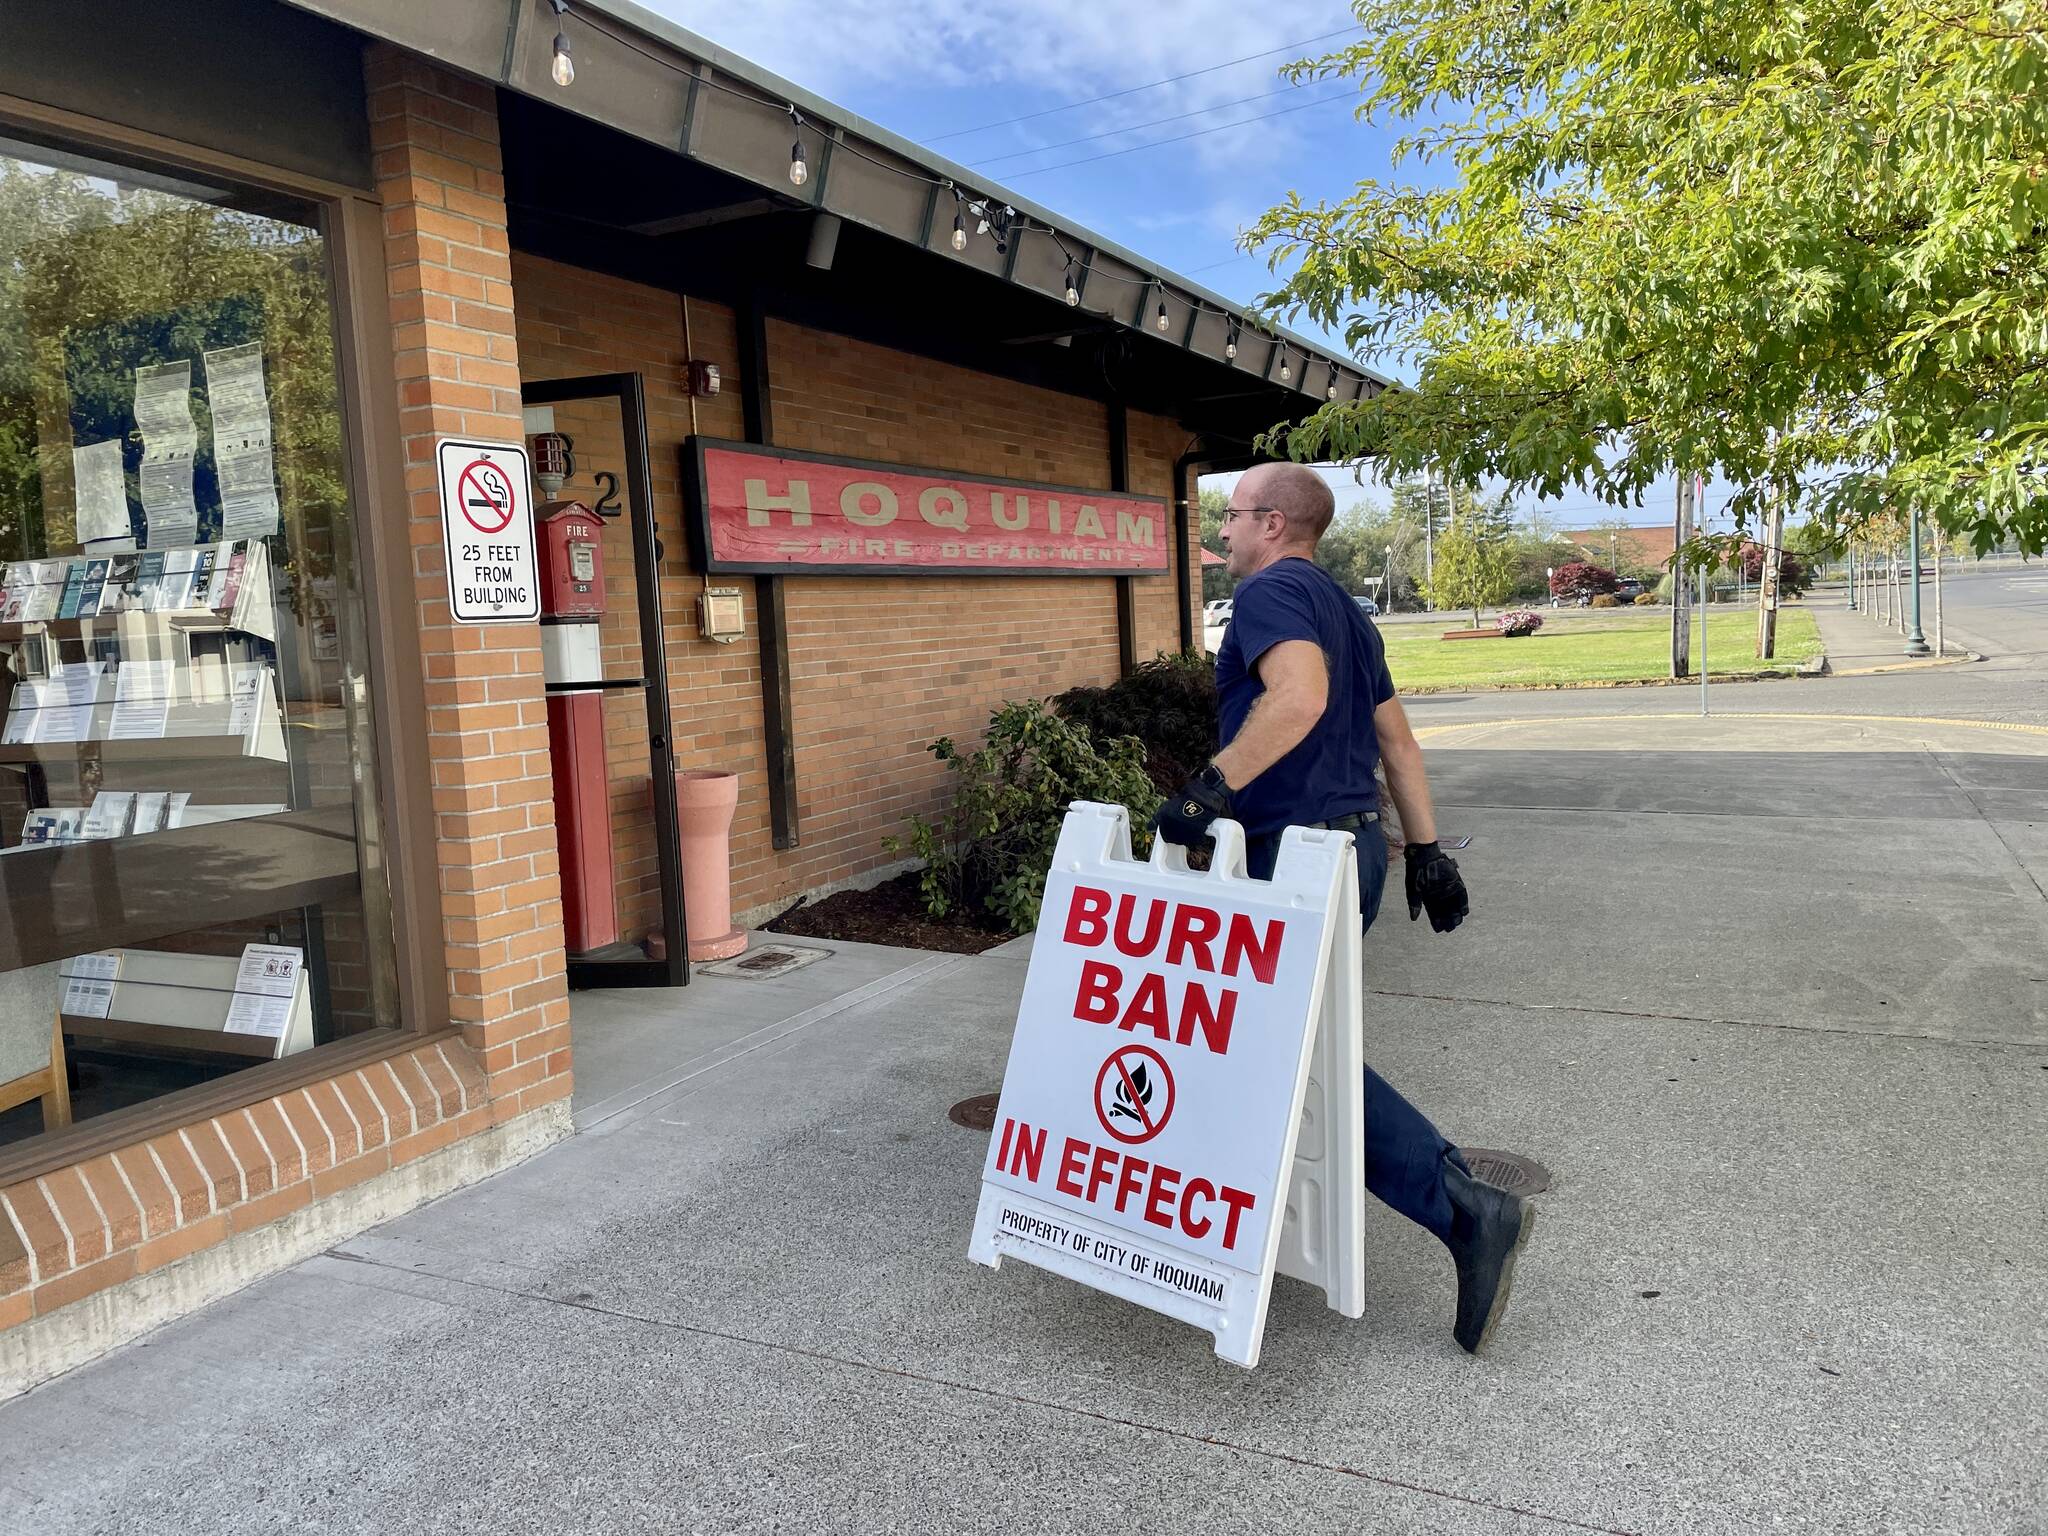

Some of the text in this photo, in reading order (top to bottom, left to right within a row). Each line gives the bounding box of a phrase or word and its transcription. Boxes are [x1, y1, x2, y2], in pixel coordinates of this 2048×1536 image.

[566, 525, 588, 536] FIRE
[744, 479, 1153, 547] HOQUIAM
[462, 544, 520, 561] 25 FEET
[820, 537, 1124, 561] FIRE DEPARTMENT
[464, 587, 527, 604] BUILDING
[475, 566, 512, 582] FROM
[1063, 885, 1286, 985] BURN
[1073, 959, 1239, 1055] BAN
[996, 1118, 1256, 1250] IN EFFECT
[1001, 1208, 1224, 1302] PROPERTY OF CITY OF HOQUIAM
